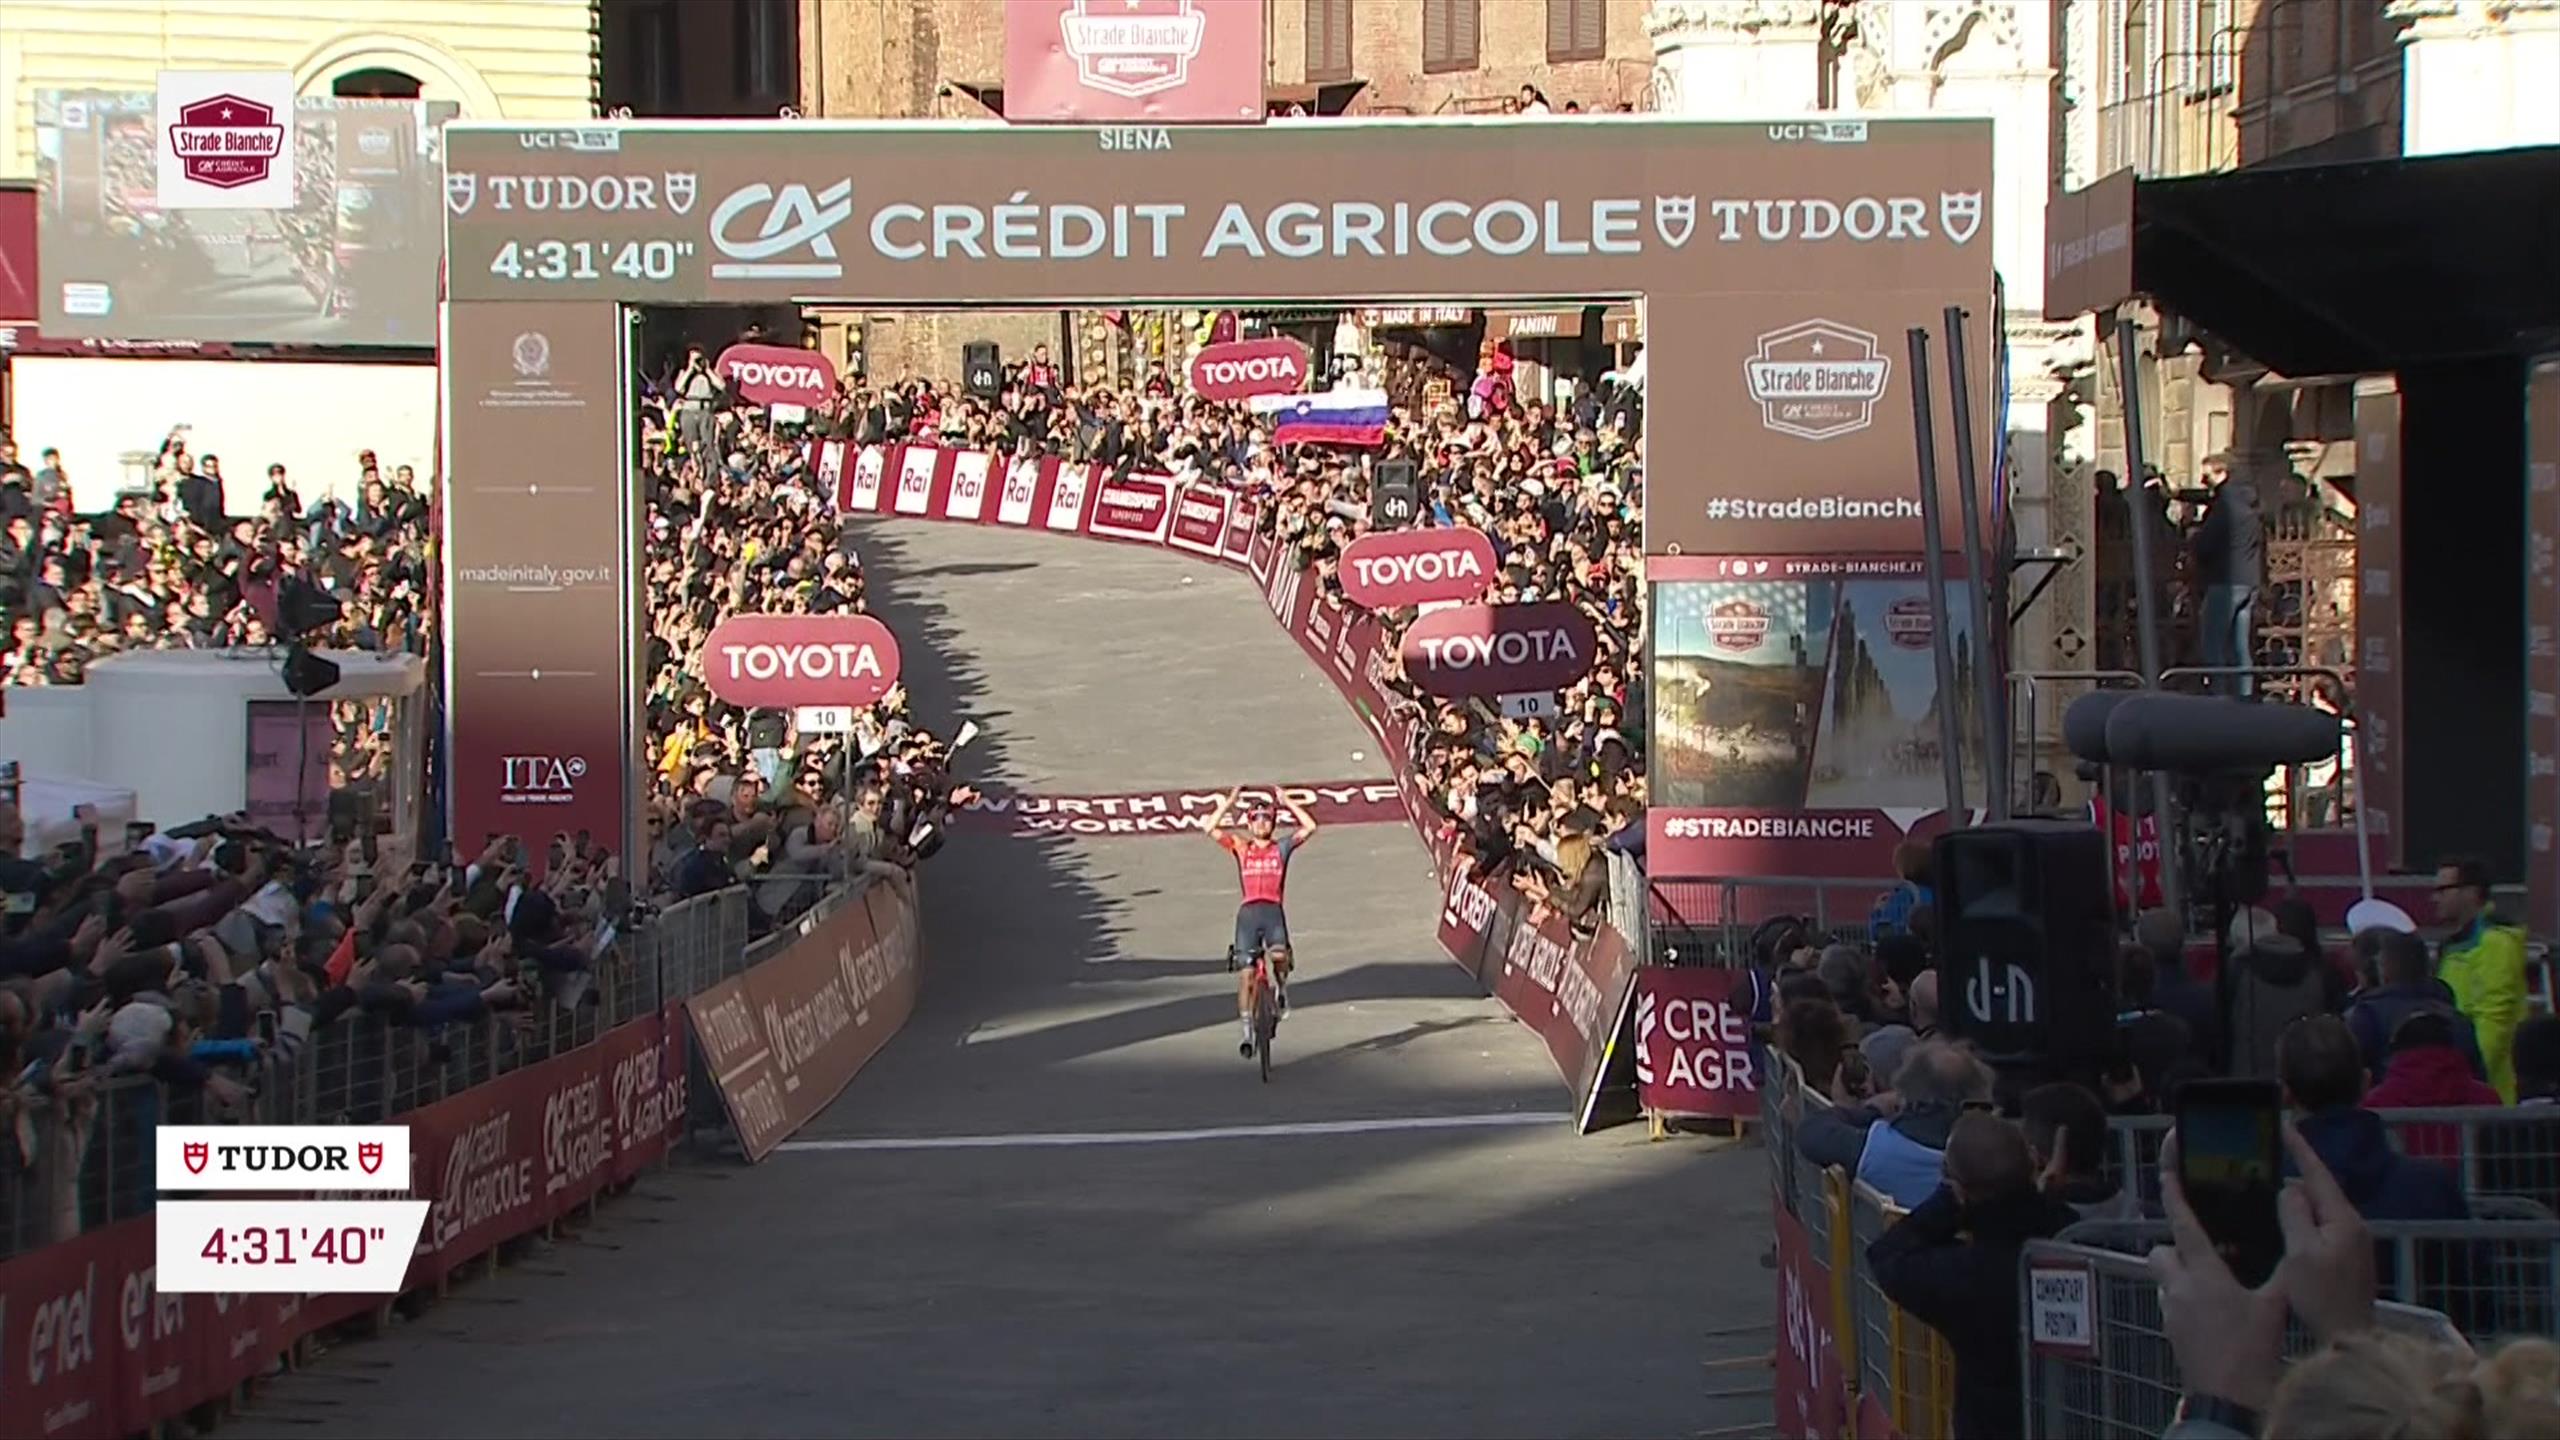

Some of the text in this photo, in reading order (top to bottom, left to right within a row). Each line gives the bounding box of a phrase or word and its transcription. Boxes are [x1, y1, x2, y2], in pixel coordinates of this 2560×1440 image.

[520, 132, 556, 149] UCI
[1100, 128, 1171, 150] SIENA
[1768, 124, 1804, 140] UCI
[488, 175, 657, 210] TUDOR
[870, 190, 1185, 258] CRÉDIT
[1202, 200, 1641, 257] AGRICOLE
[1711, 197, 1929, 241] TUDOR
[490, 240, 694, 280] 4:31'40"
[1382, 307, 1465, 324] MADE IN ITALY
[1509, 315, 1557, 336] PANINI
[728, 358, 824, 390] TOYOTA
[1201, 355, 1298, 386] TOYOTA
[1761, 367, 1876, 392] Strade Bianche
[857, 464, 880, 491] Rai
[903, 467, 930, 494] Rai
[954, 471, 982, 500] Rai
[1007, 476, 1033, 504] Rai
[1056, 482, 1083, 510] Rai
[1706, 496, 1924, 520] #StradeBianche
[459, 563, 612, 587] madeinitaly.gov.it
[1352, 550, 1482, 588] TOYOTA
[1785, 561, 1925, 575] STRADE-BIANCHE.IT
[721, 642, 882, 680] TOYOTA
[1419, 629, 1577, 671] TOYOTA
[814, 711, 836, 727] 10
[1517, 697, 1538, 714] 10
[501, 756, 574, 790] ITA
[1664, 817, 1874, 839] #STRADEBIANCHE
[463, 1157, 533, 1231] AGRICOLE
[28, 1261, 95, 1386] enel
